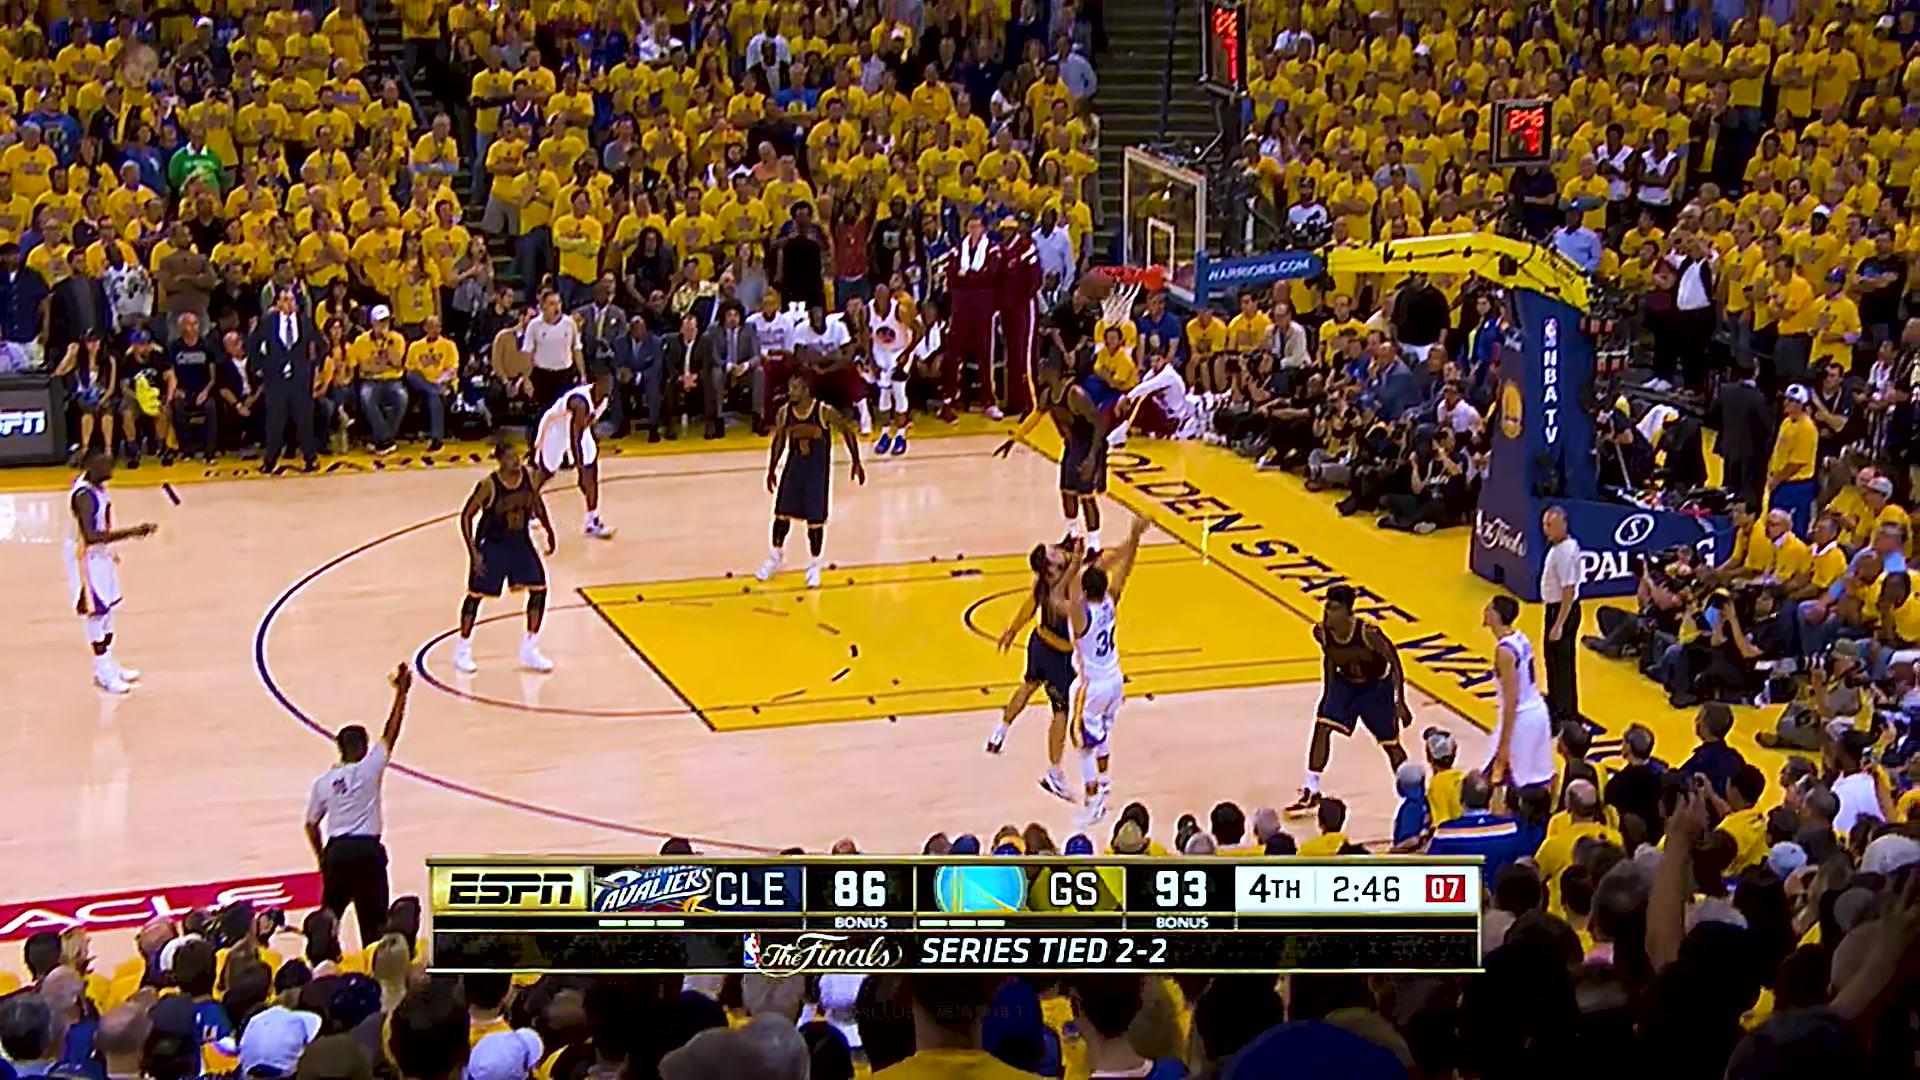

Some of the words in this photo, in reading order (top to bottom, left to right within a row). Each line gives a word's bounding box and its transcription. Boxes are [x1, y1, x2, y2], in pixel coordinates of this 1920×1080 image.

[1208, 258, 1311, 281] WARRIORS.COM
[1543, 350, 1558, 404] NBA
[1544, 408, 1558, 444] TV
[1107, 452, 1264, 533] OLDEN
